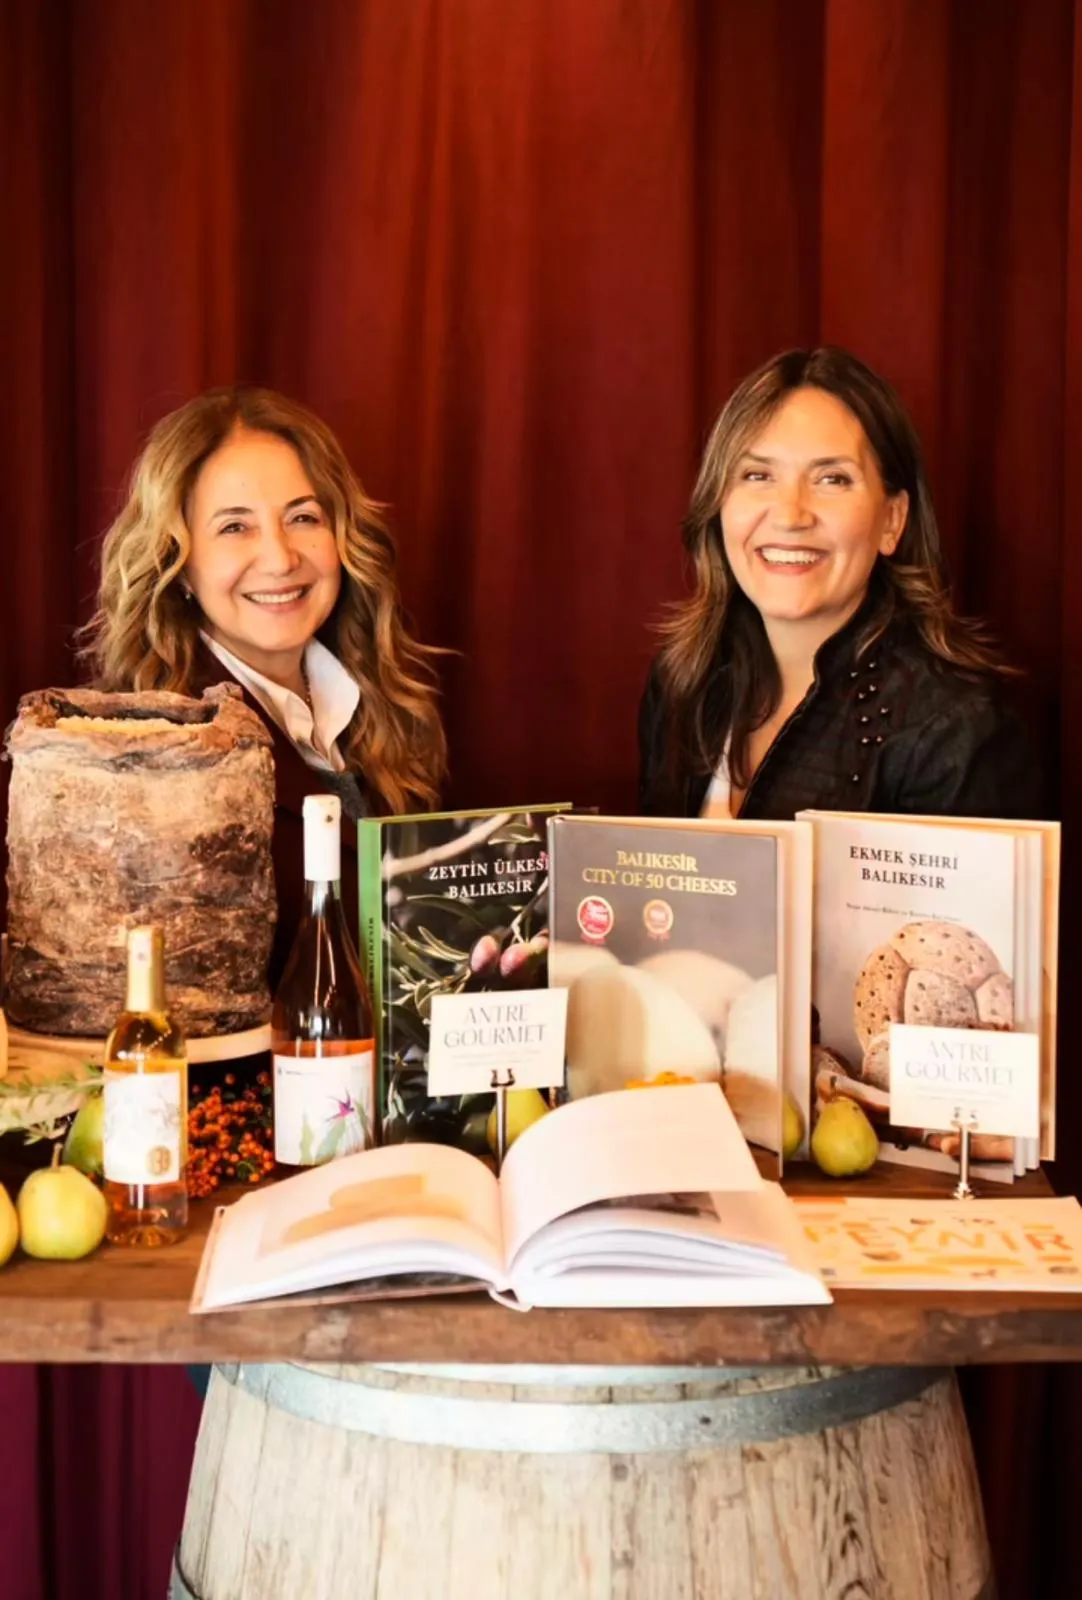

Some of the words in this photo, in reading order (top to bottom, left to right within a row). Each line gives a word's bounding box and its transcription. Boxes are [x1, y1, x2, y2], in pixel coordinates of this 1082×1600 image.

[616, 850, 698, 872] BALIKESİR
[849, 845, 904, 864] EKMEK
[909, 851, 959, 870] ŞEHRİ
[429, 860, 488, 881] ZEYTİN
[582, 867, 618, 885] CITY
[621, 870, 644, 887] OF
[645, 873, 664, 889] 50
[666, 875, 737, 896] CHEESES
[448, 877, 533, 899] BALIKESİR
[466, 1004, 530, 1024] ANTRE
[444, 1023, 547, 1048] GOURMET
[904, 1061, 1015, 1086] GOURMET
